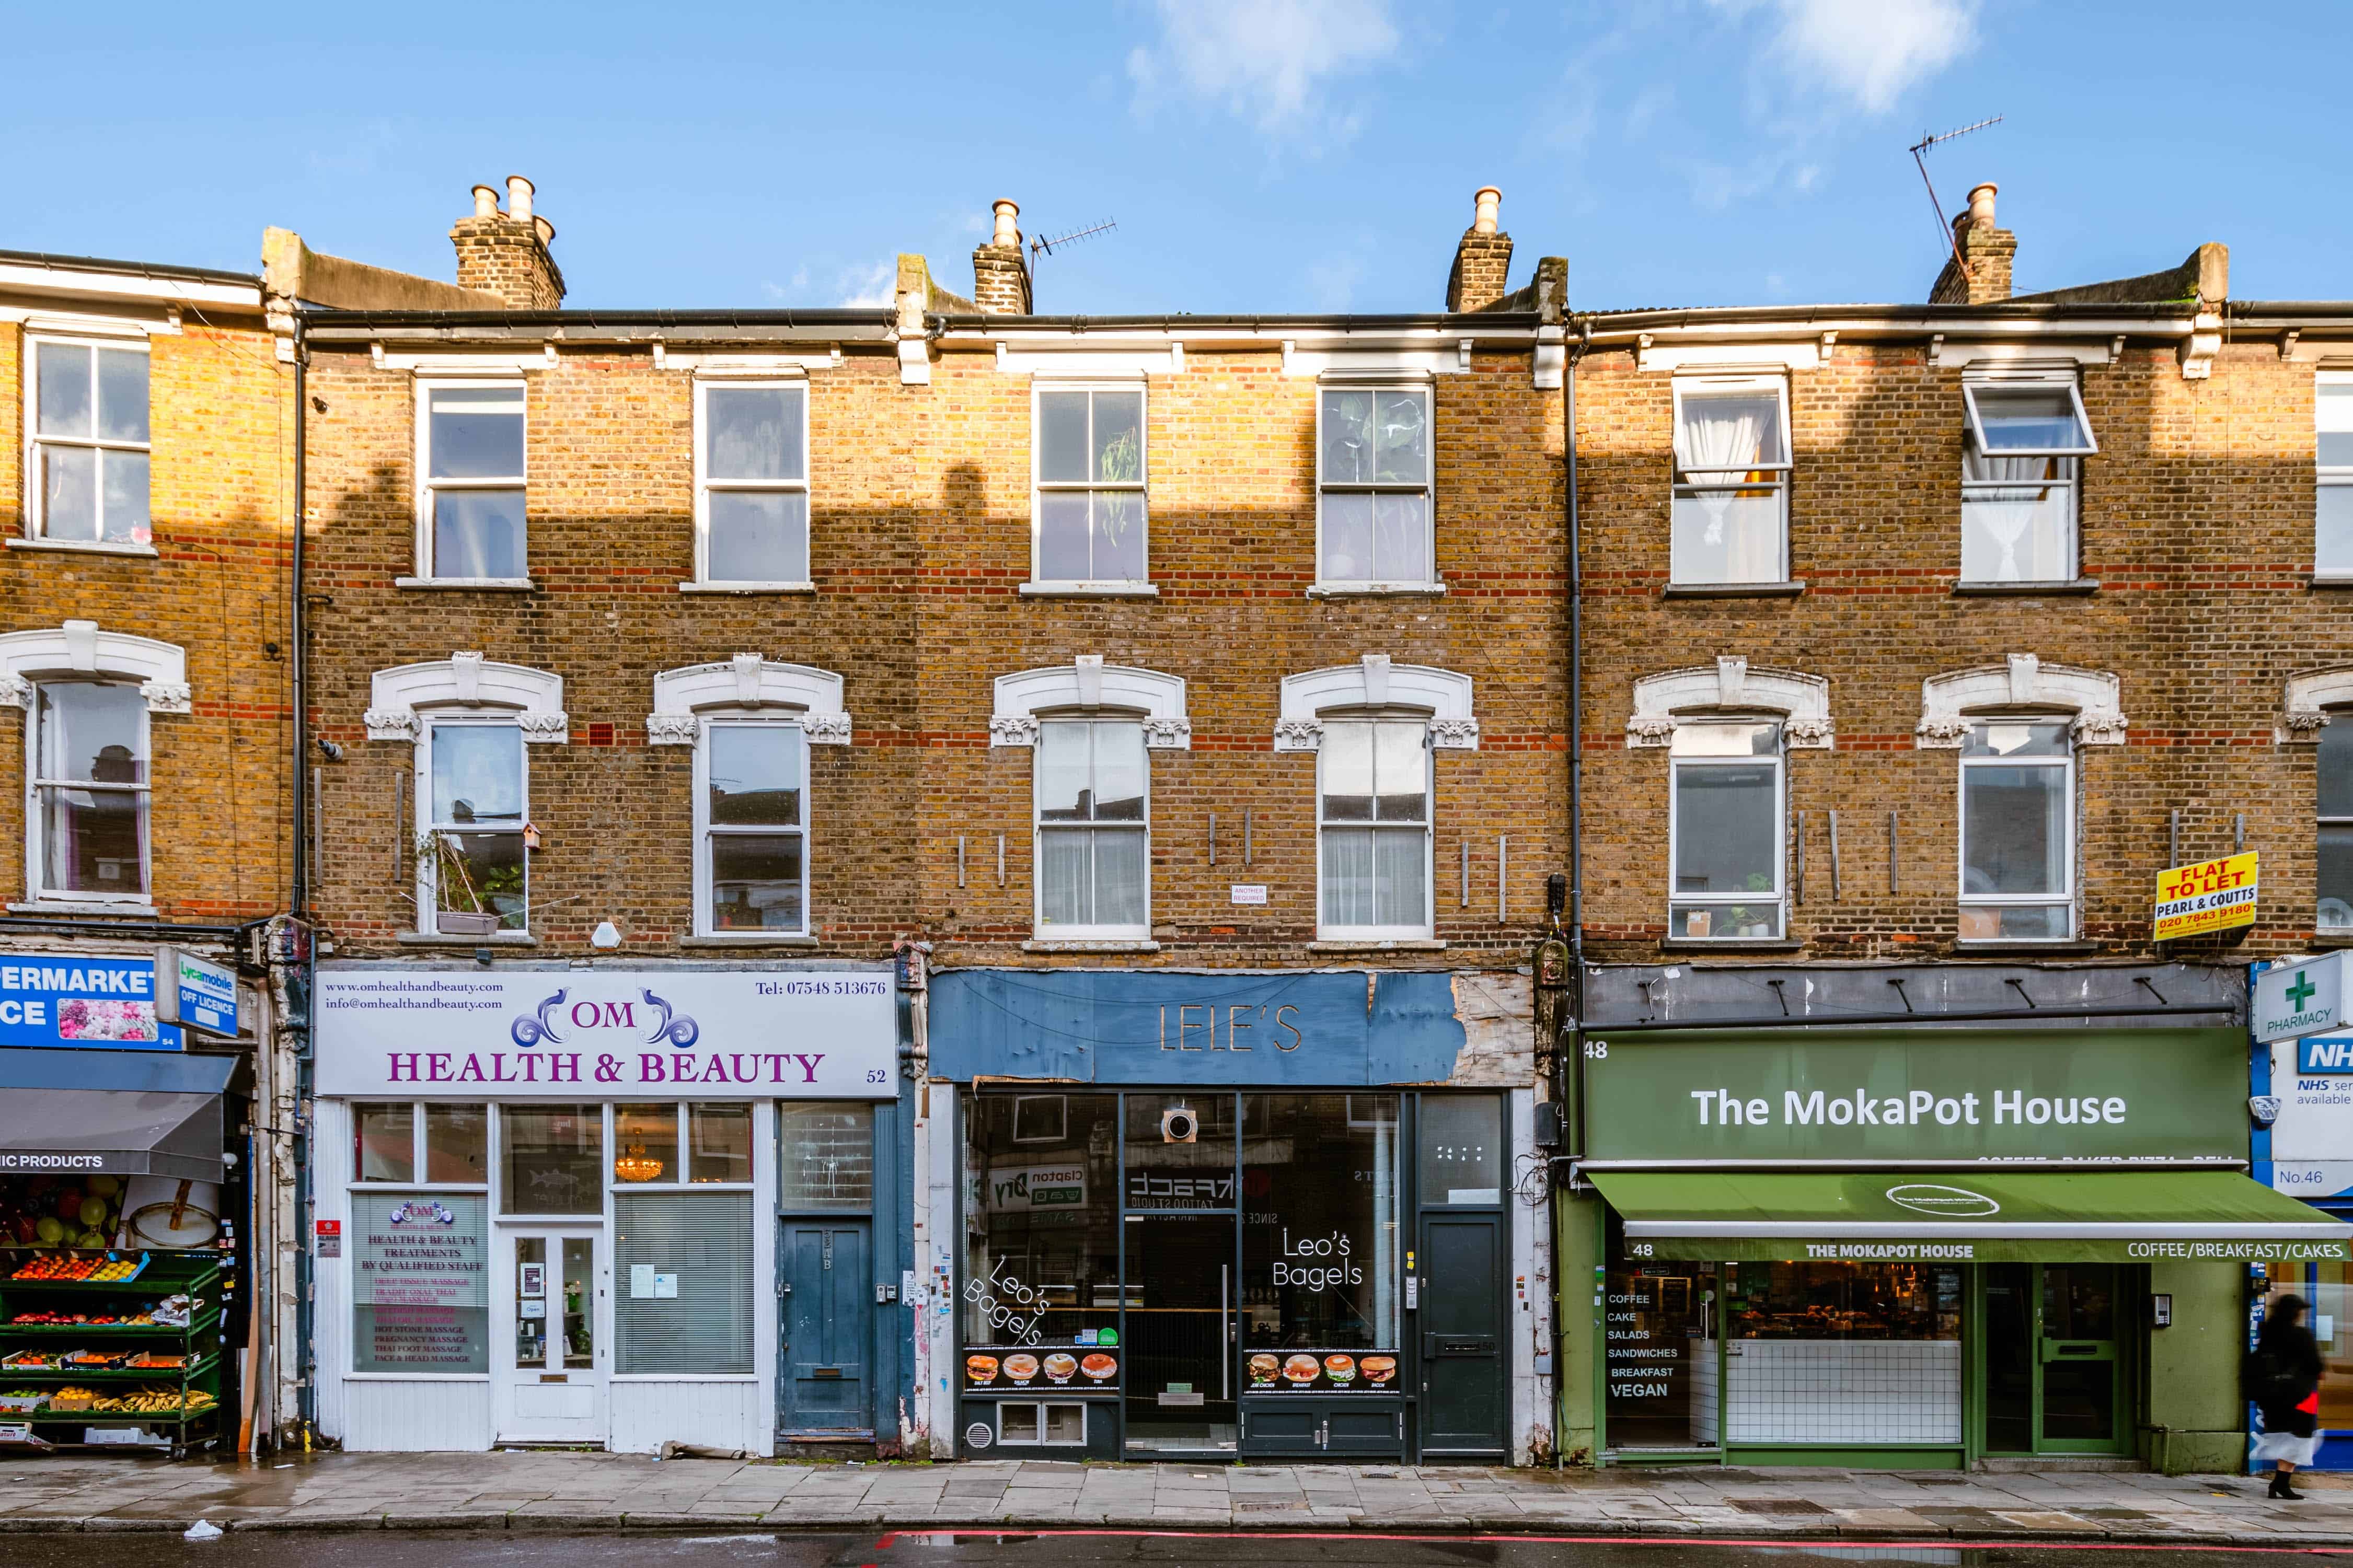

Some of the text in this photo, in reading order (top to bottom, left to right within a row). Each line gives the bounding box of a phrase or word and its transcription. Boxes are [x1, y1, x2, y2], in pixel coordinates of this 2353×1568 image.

[2181, 860, 2230, 882] FLAT
[2166, 870, 2245, 899] TO LET
[2157, 888, 2254, 917] PEARL & COUTTS
[2160, 917, 2182, 928] 020
[2186, 911, 2216, 924] 7843
[2220, 904, 2251, 917] 9180
[0, 967, 155, 993] ERMARKE
[180, 961, 232, 991] Lycamobile
[326, 981, 503, 994] www.omhealthandbeauty.com
[755, 982, 886, 995] Tel: 07548 513676
[181, 990, 197, 1004] OFF
[199, 995, 234, 1015] LICENCE
[326, 997, 502, 1011] info@omhealthandbeauty.com
[571, 1002, 637, 1028] OM
[2267, 1008, 2332, 1033] PHARMACY
[1160, 1004, 1301, 1052] LELE'S
[1585, 1041, 1608, 1059] 48
[387, 1053, 826, 1083] HEALTH & BEAUTY
[867, 1070, 886, 1083] 52
[2297, 1080, 2329, 1090] NHS
[2297, 1094, 2351, 1104] available
[1691, 1088, 2126, 1125] The MokaPot House
[0, 1155, 102, 1167] IC PRODUCTS
[2280, 1170, 2323, 1183] No.46
[368, 1235, 477, 1245] HEALTH & BEAUTY
[1284, 1228, 1351, 1256] Leo's
[384, 1248, 462, 1258] TREATMENTS
[1633, 1244, 1653, 1256] 48
[1806, 1245, 1973, 1258] THE MOKAPOT HOUSE
[362, 1261, 483, 1271] BY QUALIFIED STAFF
[1273, 1258, 1363, 1292] Bagels
[989, 1257, 1049, 1316] Leo's
[1609, 1295, 1650, 1304] COFFEE
[963, 1279, 1042, 1346] Bagels
[1608, 1313, 1636, 1321] CAKE
[1608, 1330, 1650, 1339] SALADS
[1608, 1348, 1677, 1357] SANDWICHES
[1612, 1367, 1673, 1377] BREAKFAST
[1611, 1383, 1667, 1397] VEGAN
